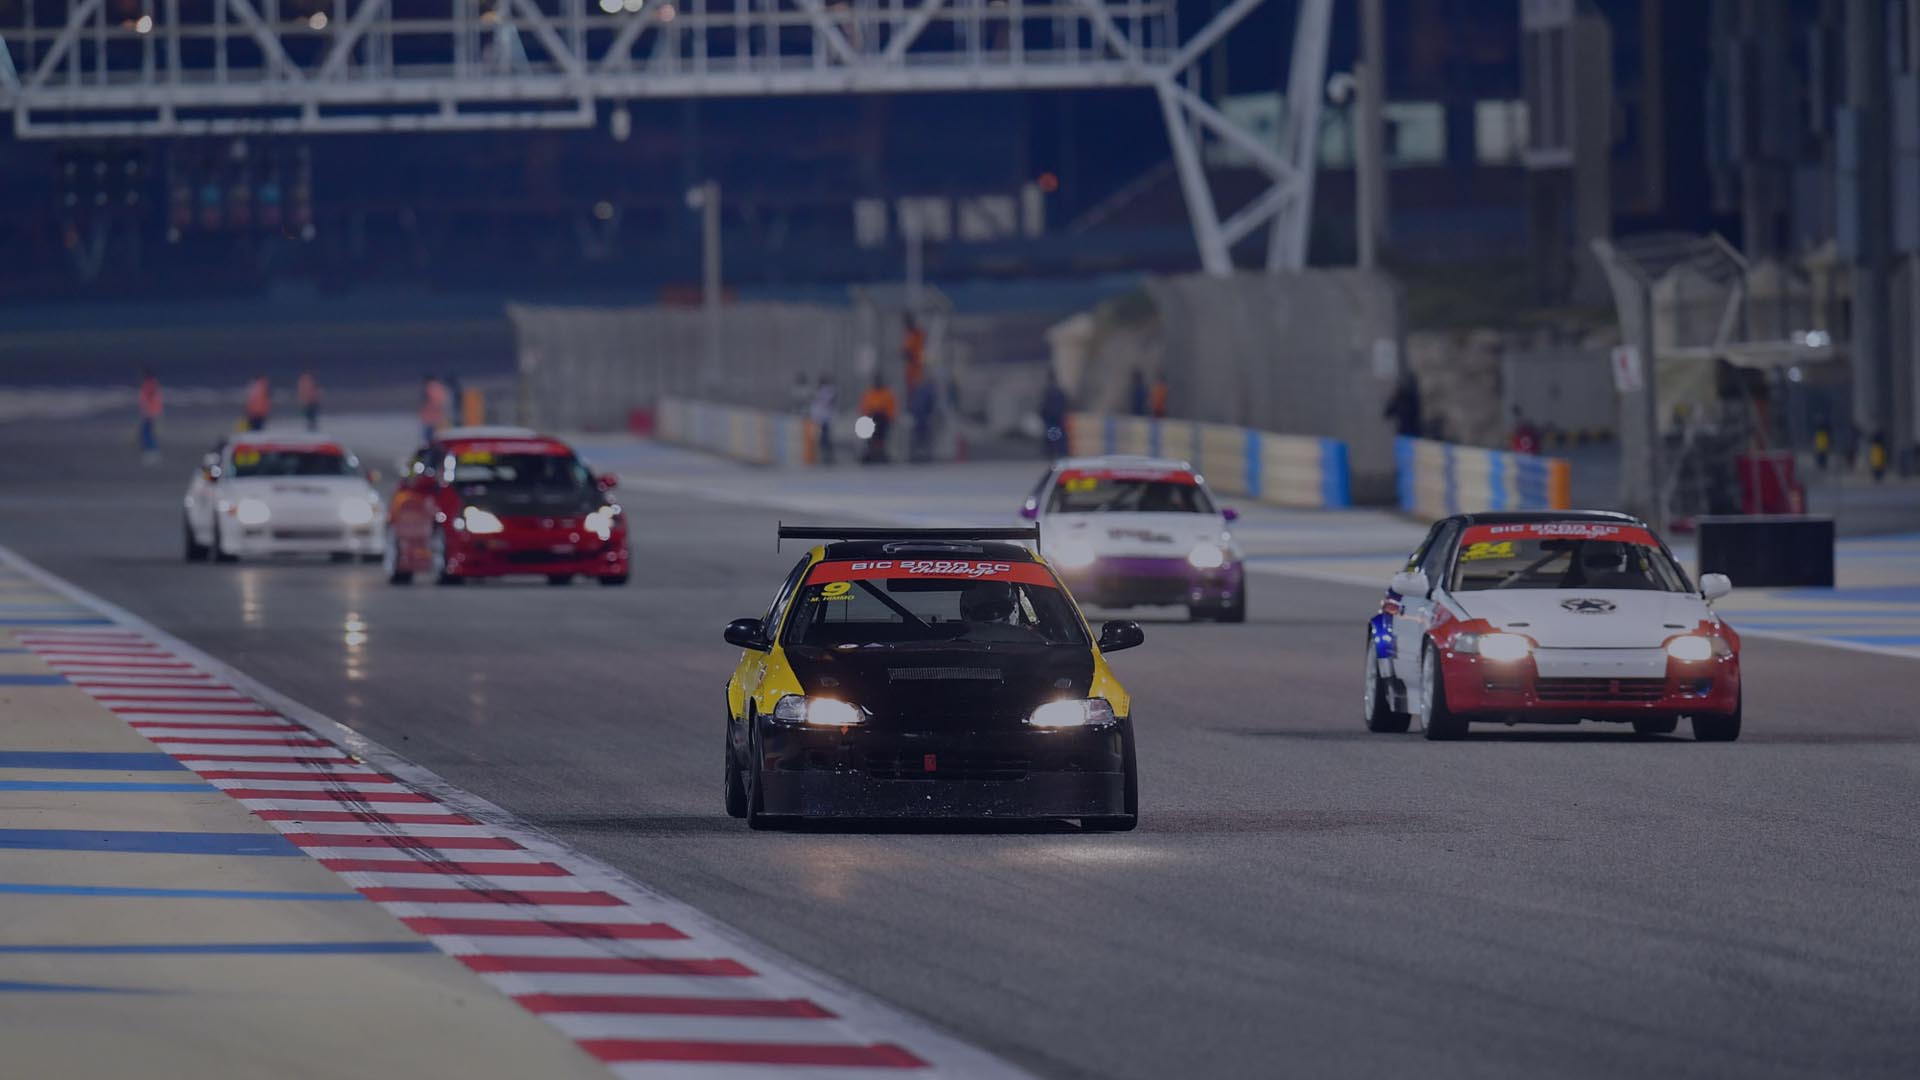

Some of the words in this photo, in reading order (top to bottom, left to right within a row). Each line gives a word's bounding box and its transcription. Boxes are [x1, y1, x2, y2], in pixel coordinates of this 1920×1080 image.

[1466, 541, 1513, 554] 24
[851, 561, 893, 571] BIC
[900, 560, 969, 570] 2000
[976, 562, 1011, 572] CC
[909, 564, 998, 578] Challenge
[821, 581, 852, 597] 9
